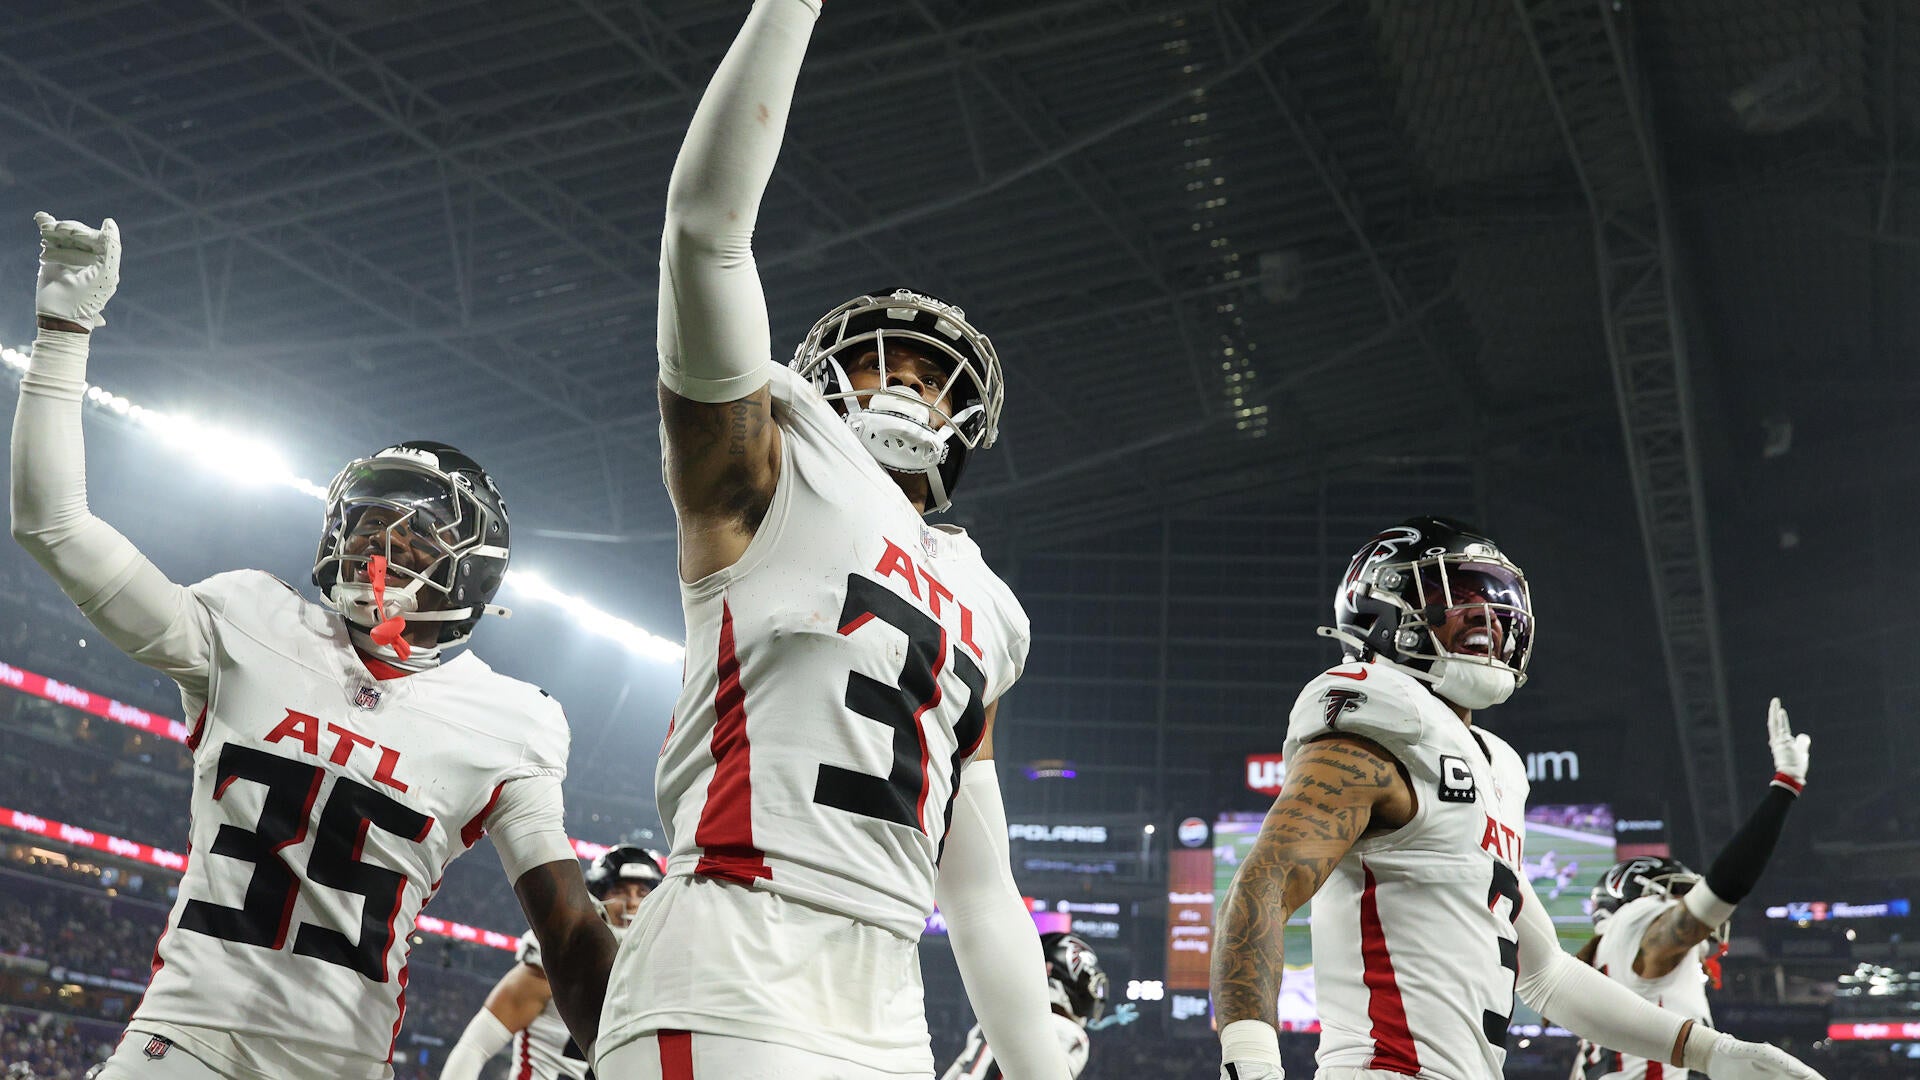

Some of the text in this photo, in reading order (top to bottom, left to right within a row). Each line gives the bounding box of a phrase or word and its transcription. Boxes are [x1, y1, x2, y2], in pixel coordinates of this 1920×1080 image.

[875, 536, 983, 661] ATL
[264, 707, 409, 793] ATL
[1443, 758, 1474, 791] C
[178, 742, 435, 983] 35
[1008, 824, 1107, 843] POLARIS
